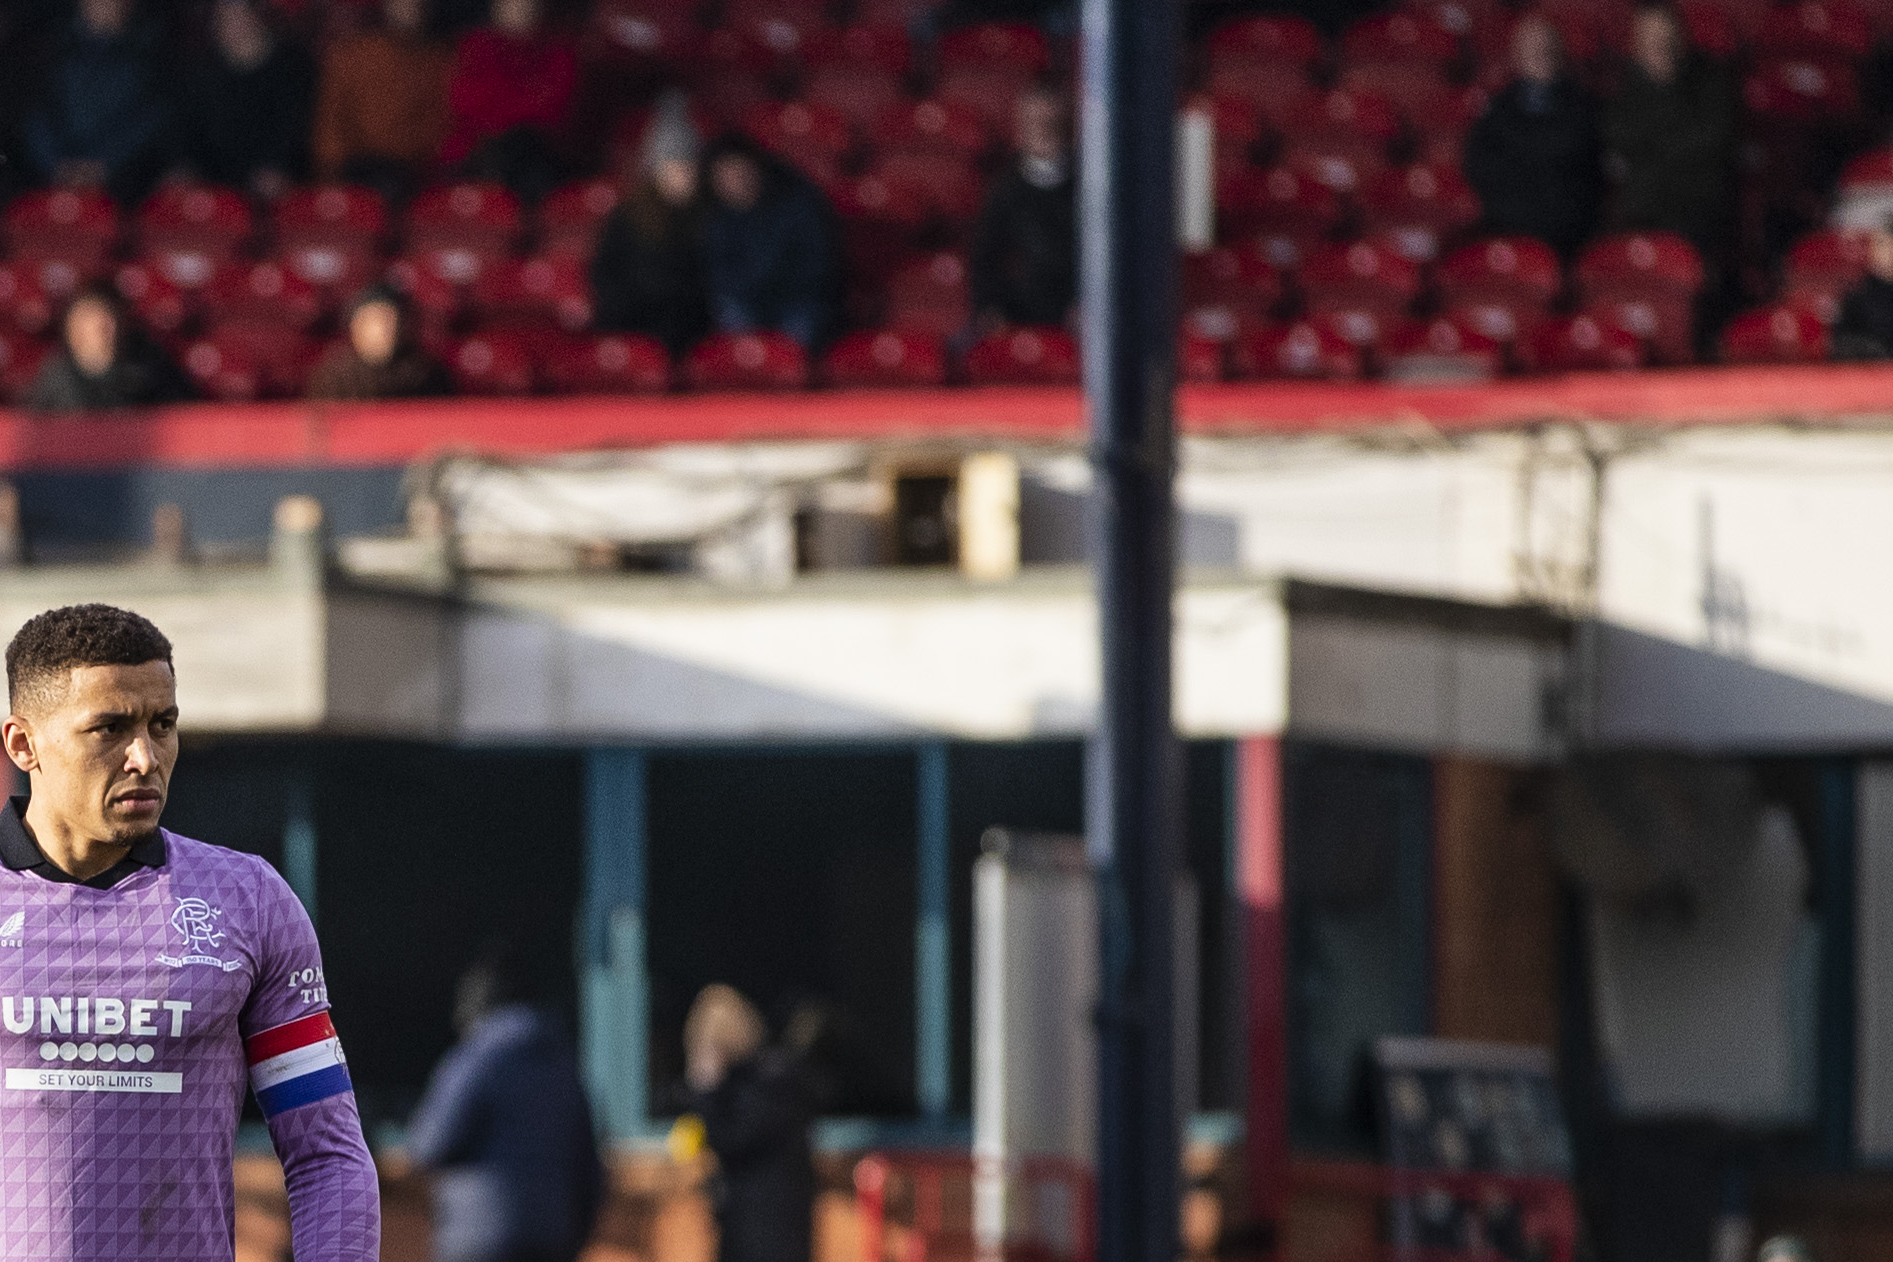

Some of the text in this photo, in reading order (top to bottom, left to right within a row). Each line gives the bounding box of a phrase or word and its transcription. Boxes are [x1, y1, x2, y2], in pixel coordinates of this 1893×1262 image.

[2, 996, 192, 1038] UNIBET
[39, 1073, 153, 1088] SET YOUR LIMITS
